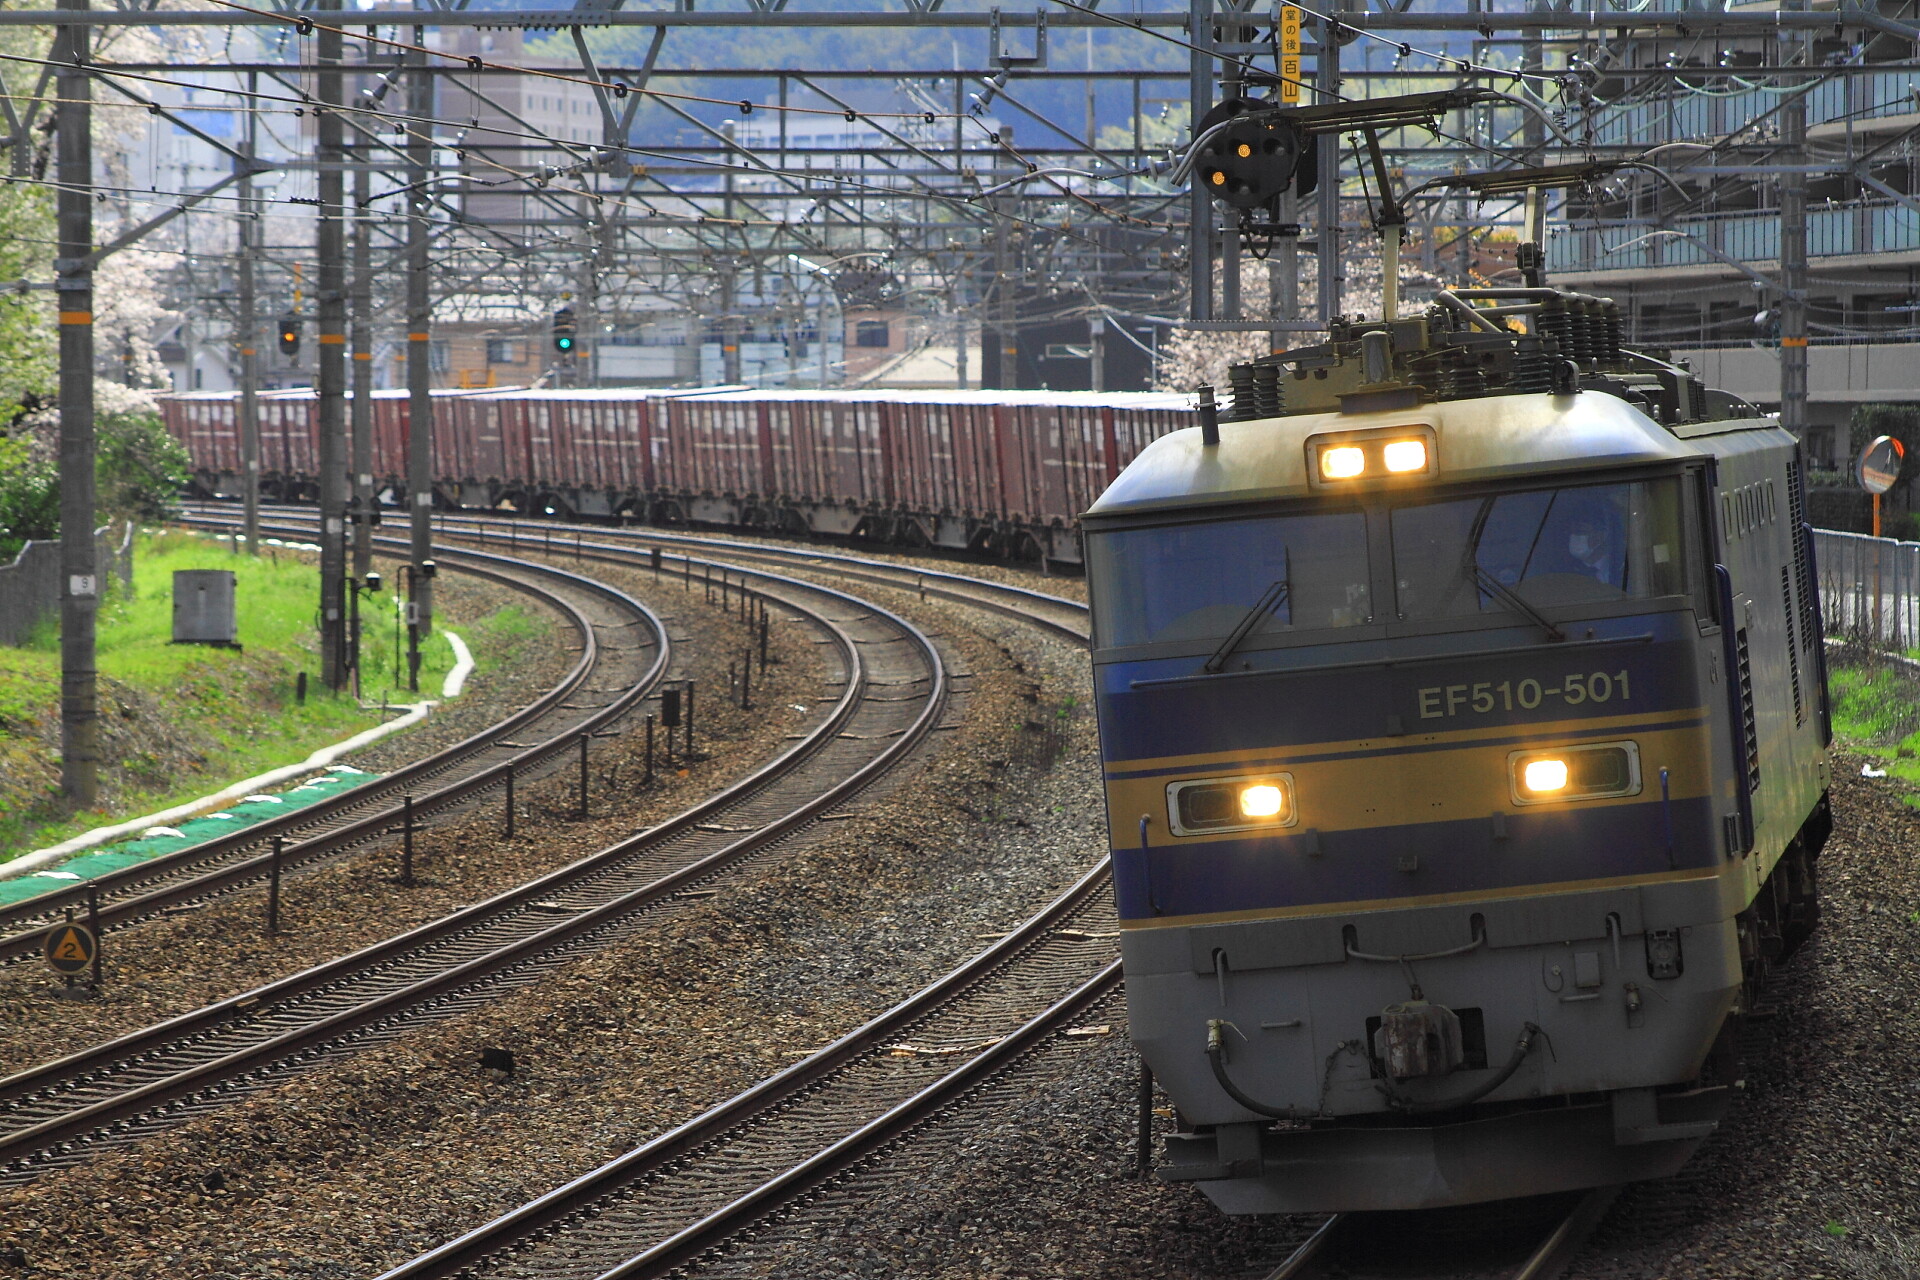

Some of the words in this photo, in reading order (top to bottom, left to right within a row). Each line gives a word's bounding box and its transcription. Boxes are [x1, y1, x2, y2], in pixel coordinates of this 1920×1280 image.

[1285, 9, 1297, 50] 堂の後
[1284, 60, 1298, 97] 百山
[1418, 669, 1631, 719] EF510-501
[63, 942, 76, 958] 2
